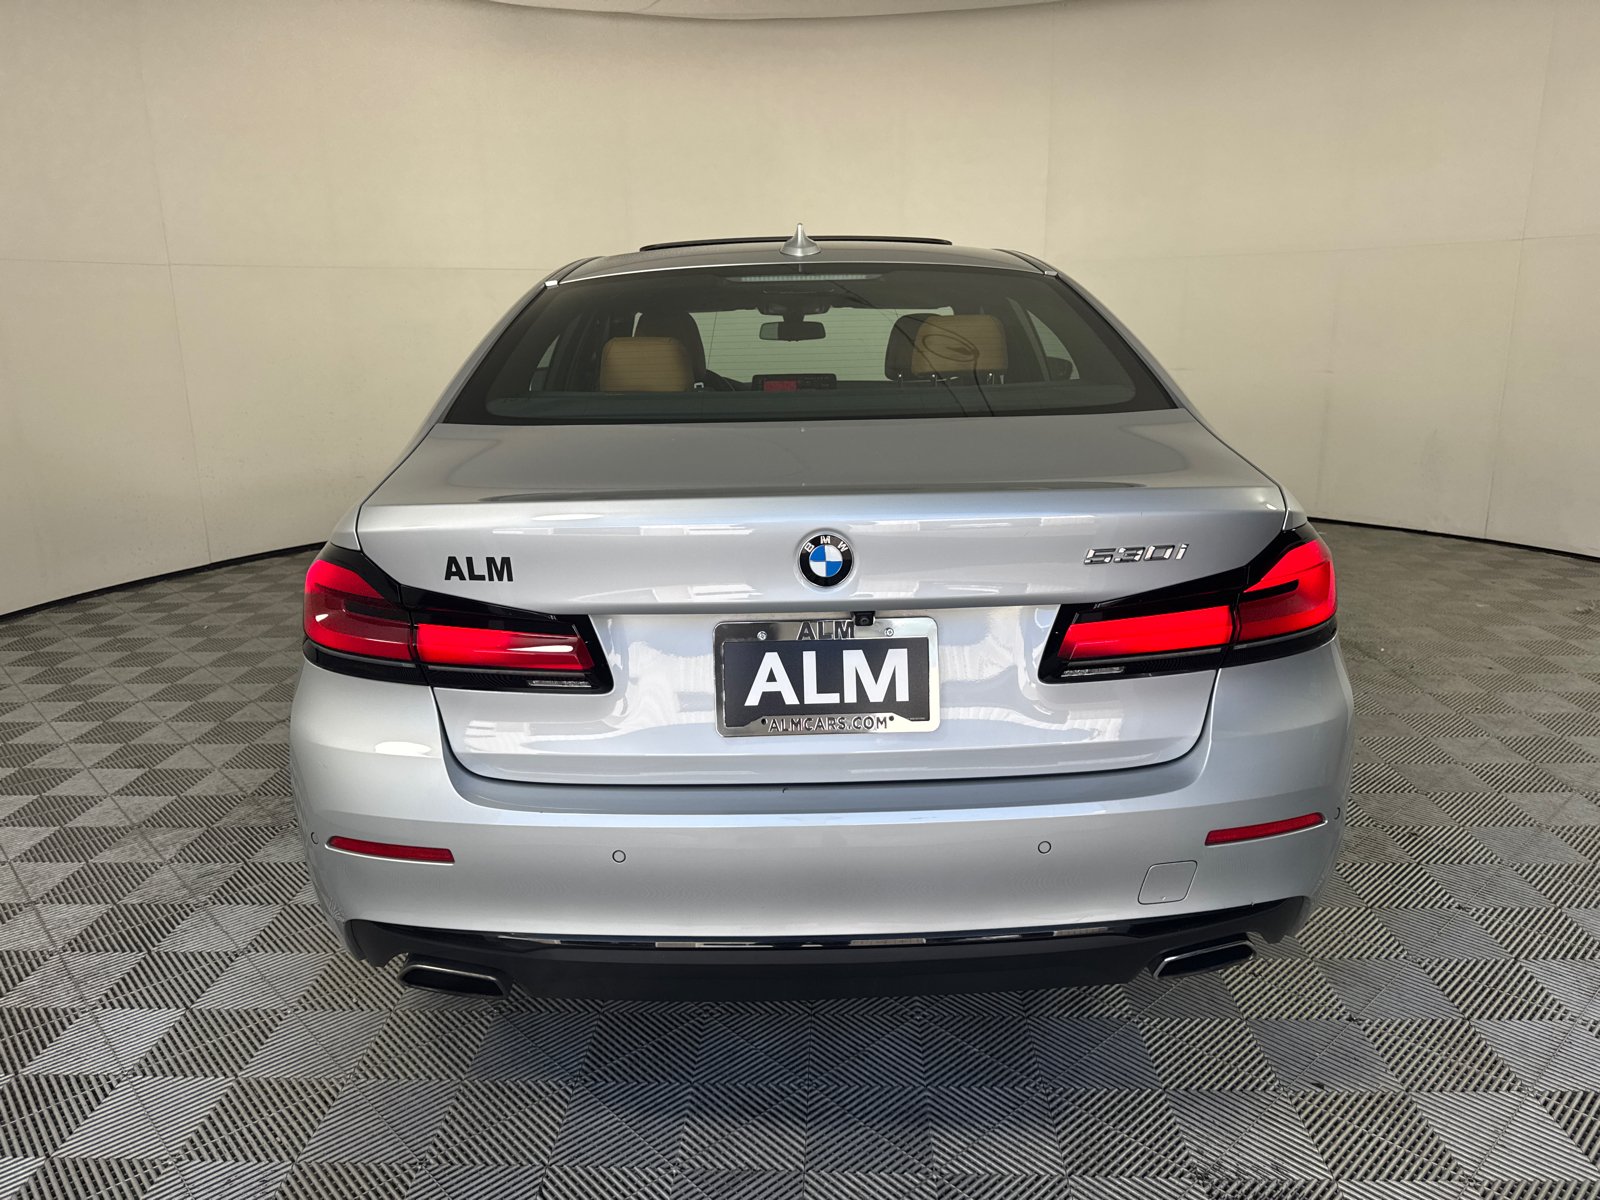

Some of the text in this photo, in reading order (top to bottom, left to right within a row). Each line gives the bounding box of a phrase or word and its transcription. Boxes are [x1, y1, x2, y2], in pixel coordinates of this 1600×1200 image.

[804, 536, 848, 552] BMW
[1083, 543, 1189, 565] 530i
[444, 556, 514, 582] ALM
[797, 620, 855, 640] ALM
[744, 648, 910, 707] ALM
[768, 714, 888, 733] ALMCARS.COM
